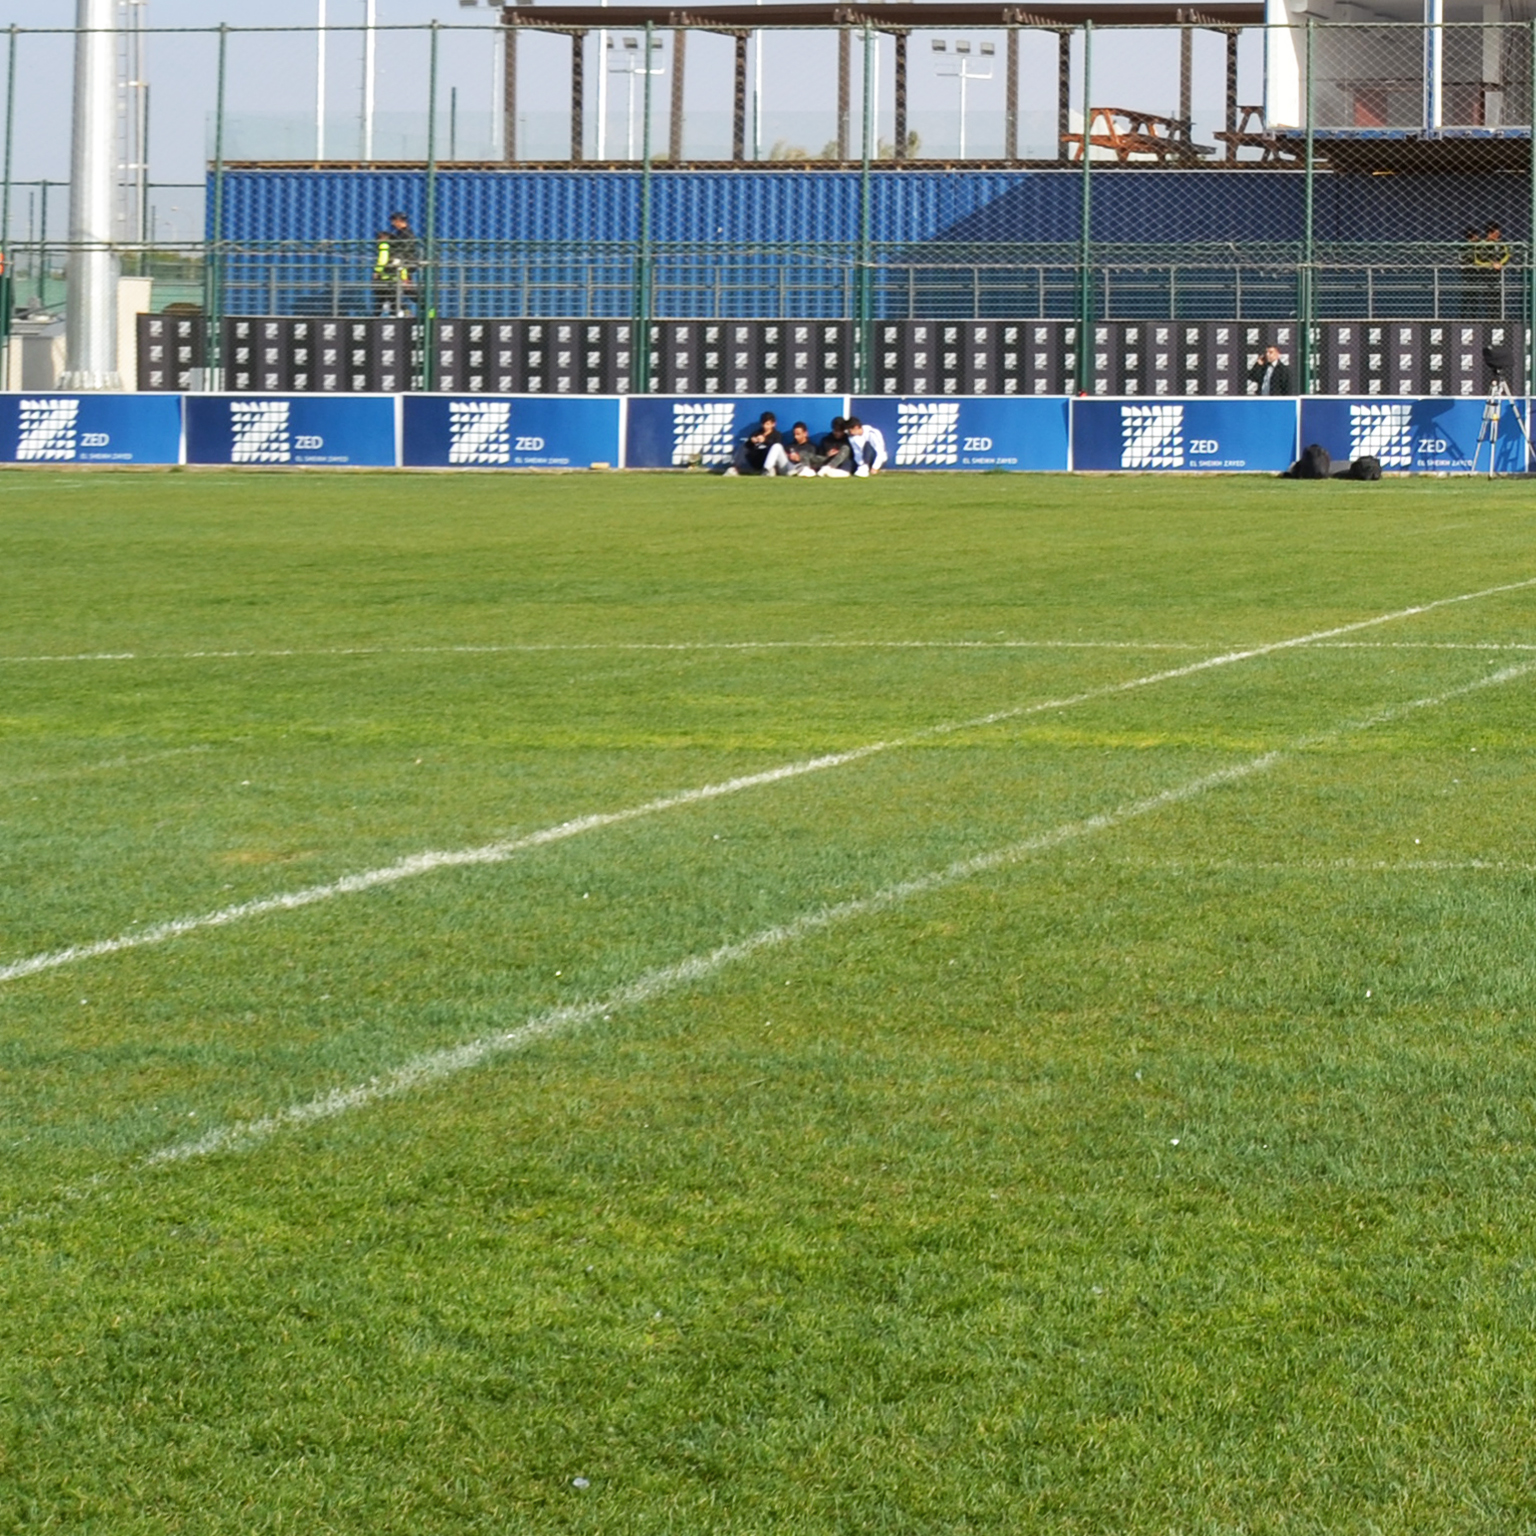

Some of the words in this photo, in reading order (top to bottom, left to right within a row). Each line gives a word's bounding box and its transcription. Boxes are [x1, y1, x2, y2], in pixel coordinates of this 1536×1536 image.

[80, 433, 110, 447] ZED
[294, 435, 324, 449] ZED
[515, 437, 545, 451] ZED
[962, 437, 992, 451] ZED
[1189, 439, 1219, 454] ZED
[1417, 439, 1447, 453] ZED
